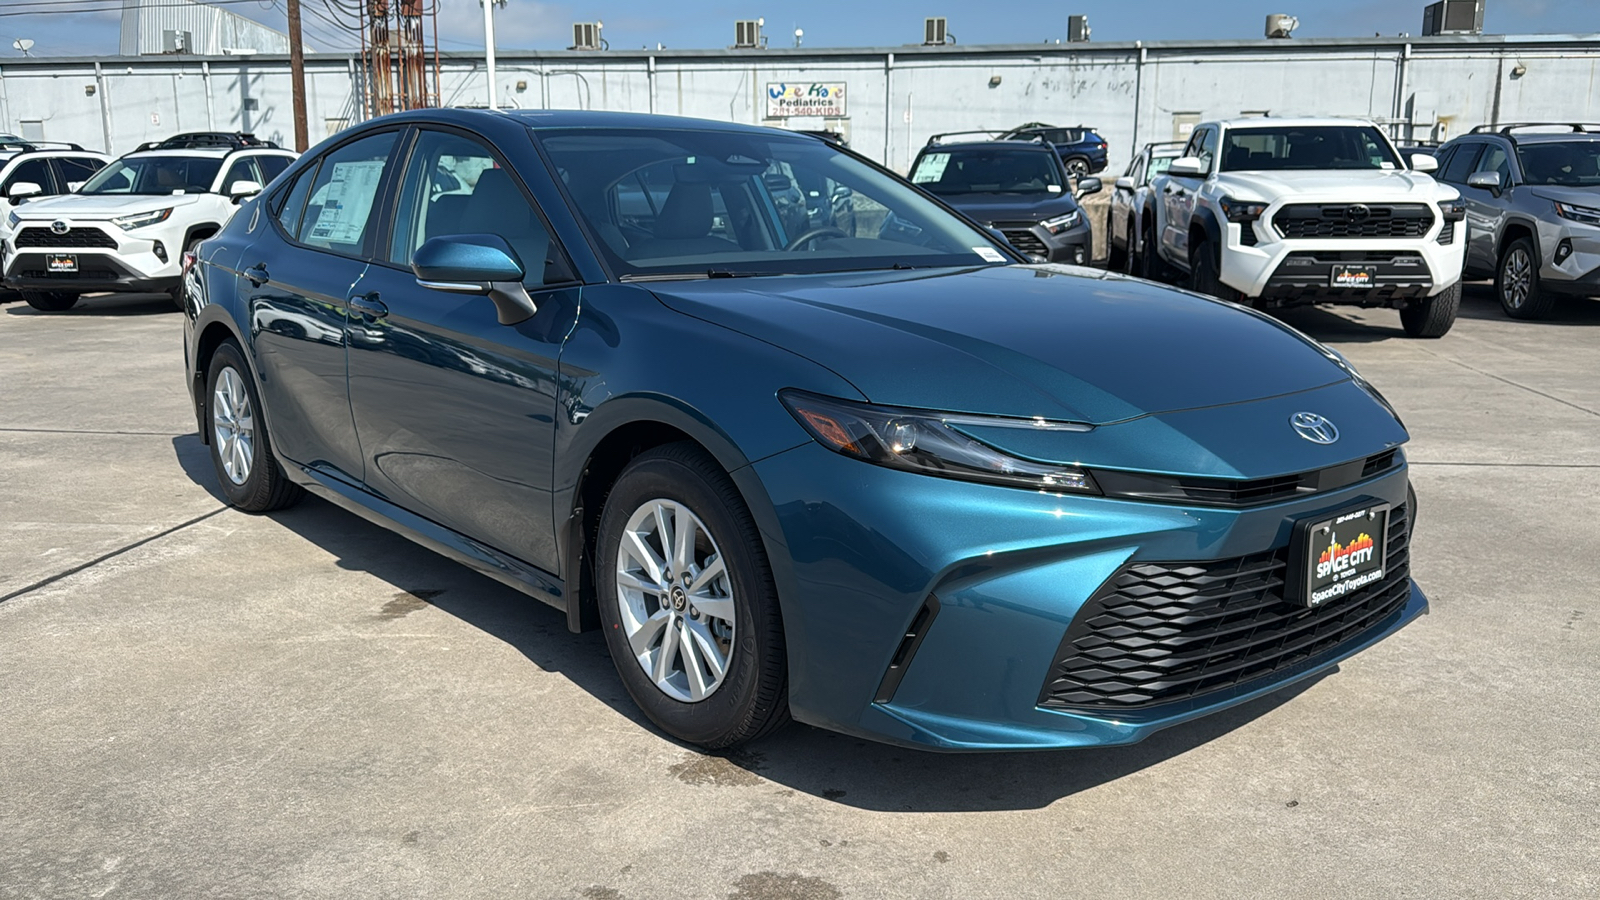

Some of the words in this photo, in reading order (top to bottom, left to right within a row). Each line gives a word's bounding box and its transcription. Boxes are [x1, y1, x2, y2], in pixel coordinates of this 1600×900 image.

[769, 83, 804, 99] Wee
[808, 83, 843, 98] Kare
[780, 99, 833, 107] Pediatrics
[1317, 554, 1349, 578] SPACE
[1350, 546, 1373, 566] CITY
[1340, 568, 1356, 578] TOYOTA
[1311, 569, 1382, 604] SpaceCityToyota.com
